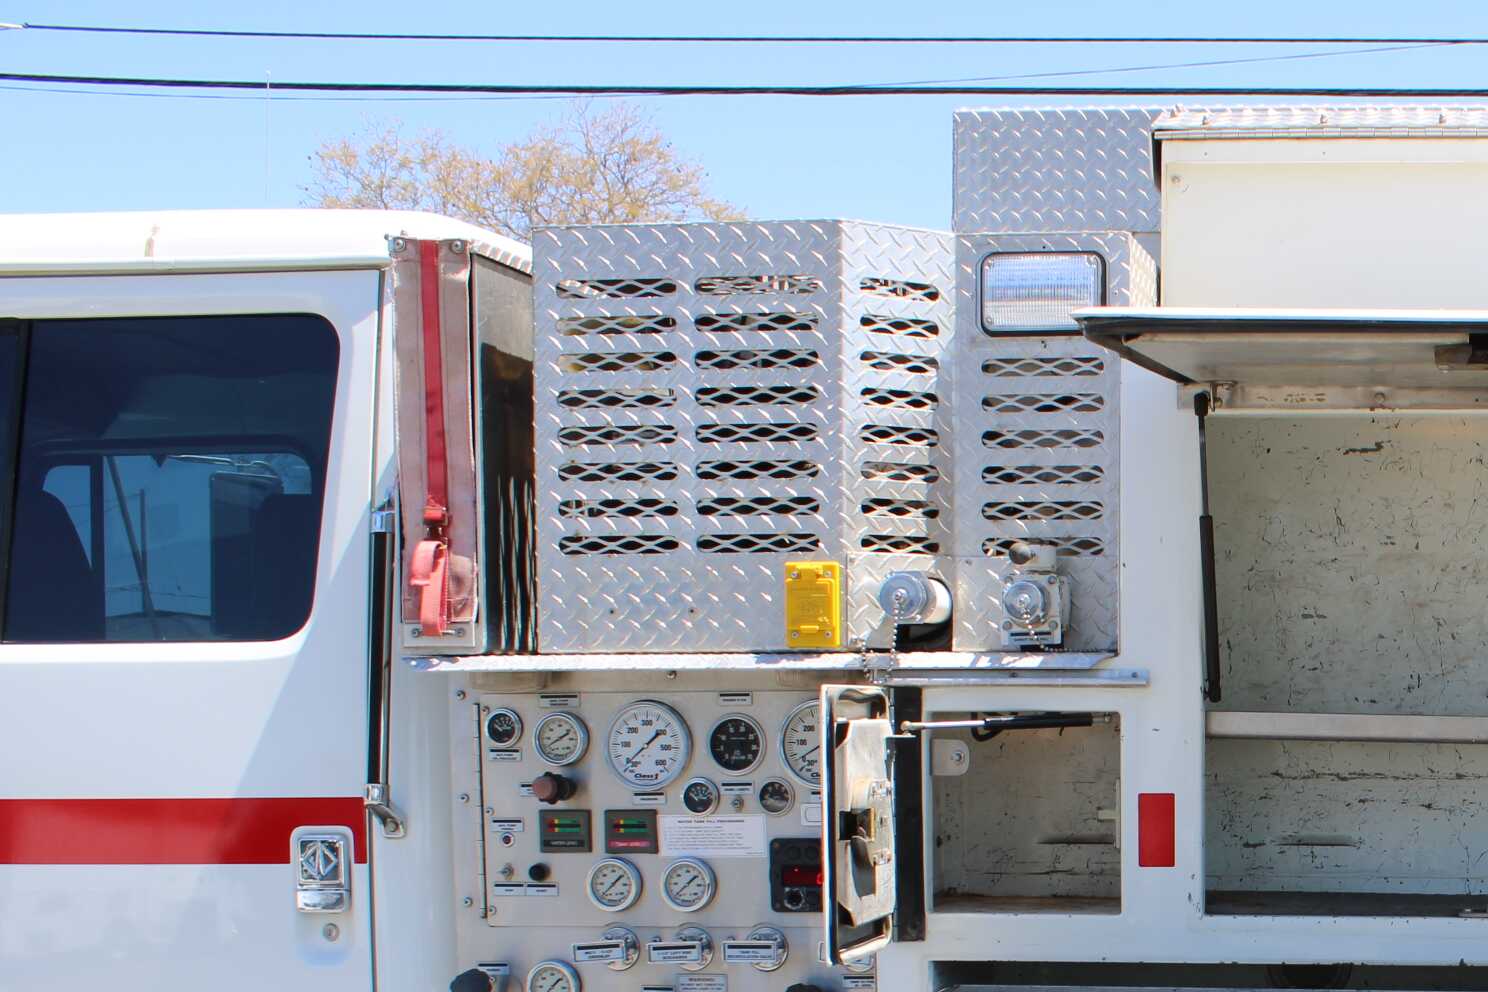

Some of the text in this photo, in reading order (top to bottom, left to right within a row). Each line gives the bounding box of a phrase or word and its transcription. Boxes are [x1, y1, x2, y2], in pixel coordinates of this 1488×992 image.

[640, 719, 653, 727] 300
[626, 726, 639, 734] 200
[660, 743, 672, 751] 500
